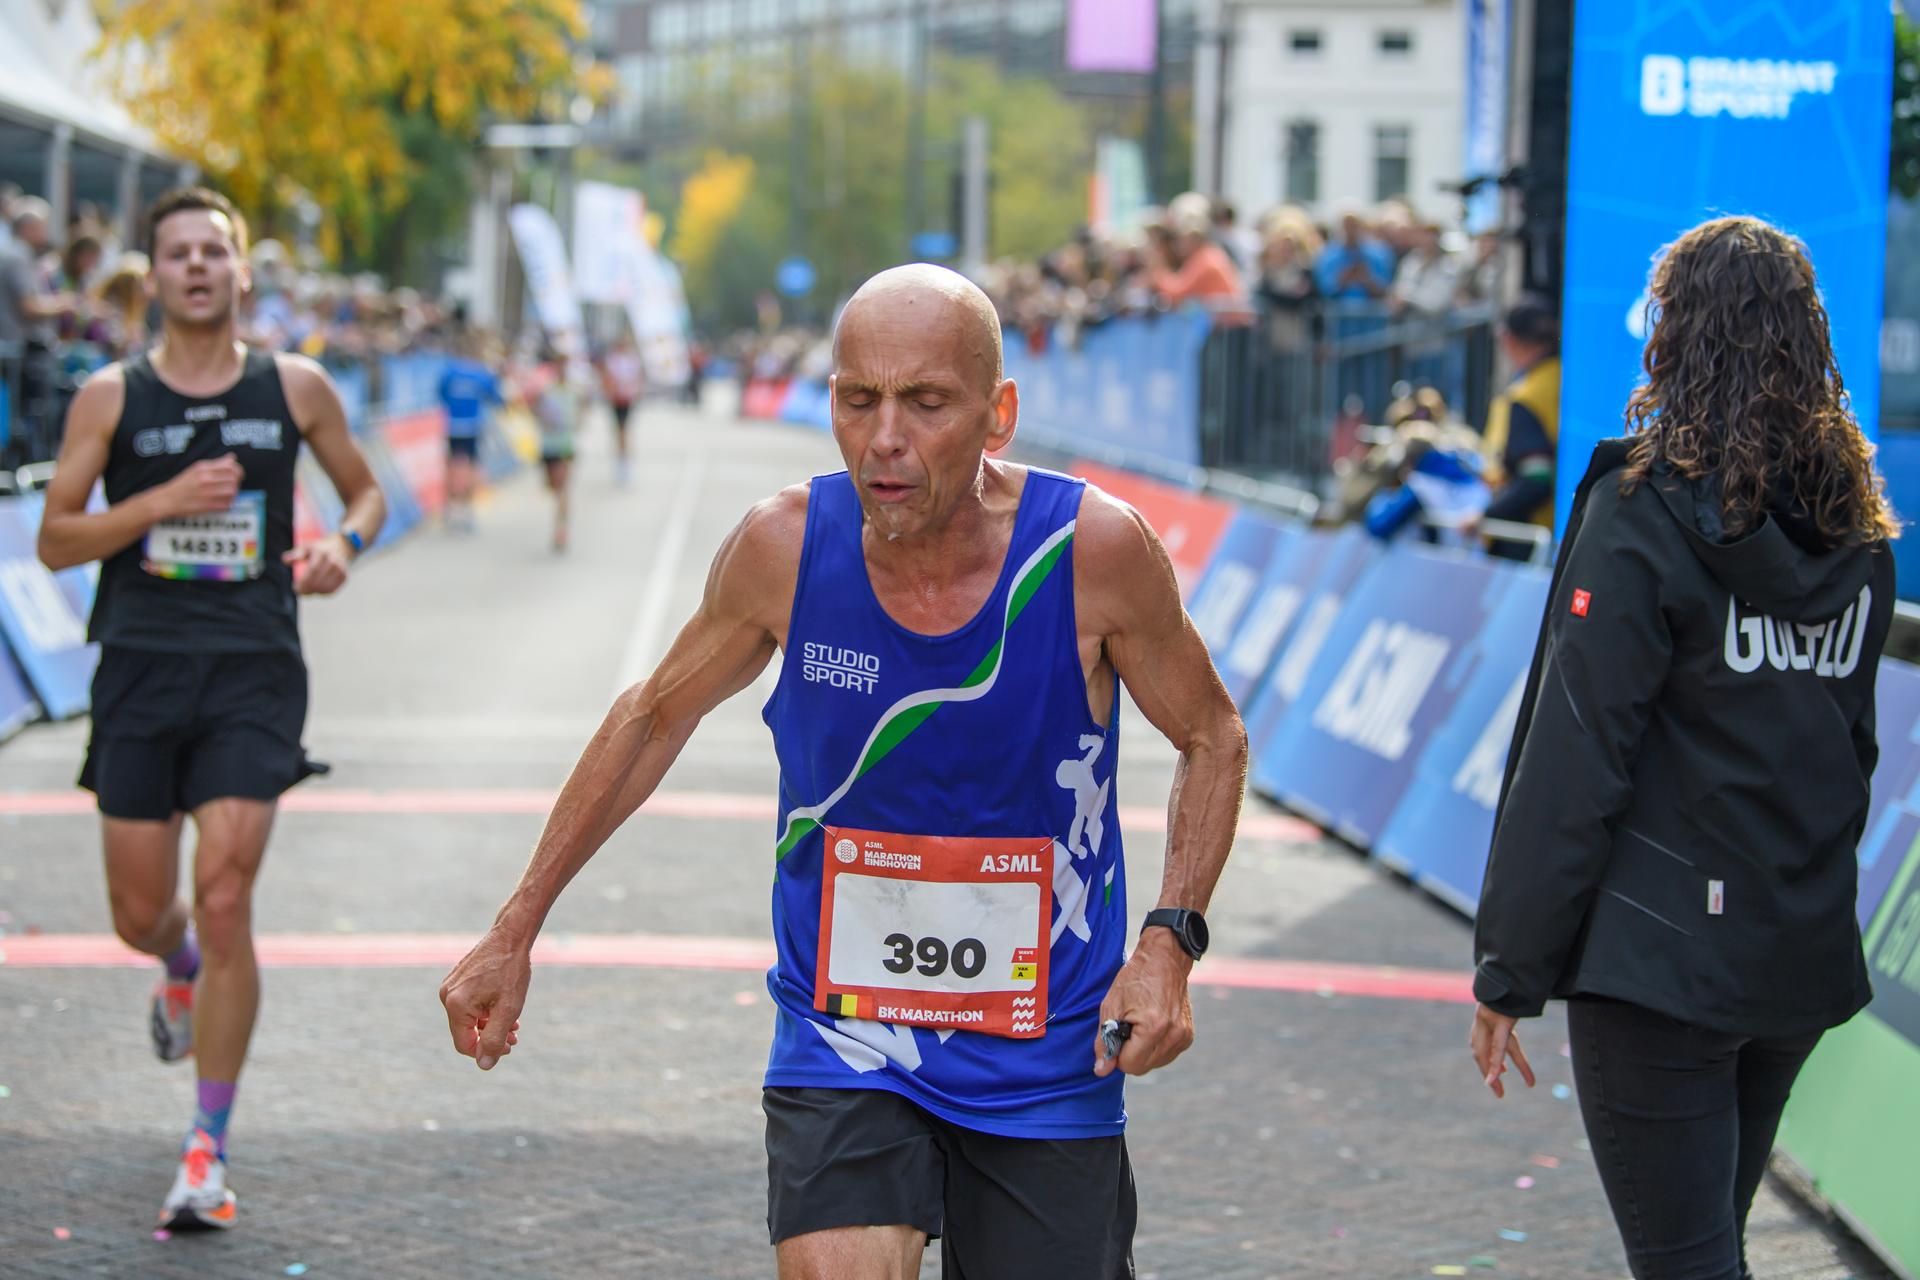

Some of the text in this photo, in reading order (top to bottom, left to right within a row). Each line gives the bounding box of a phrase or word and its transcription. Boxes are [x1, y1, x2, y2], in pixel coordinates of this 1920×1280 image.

[803, 641, 880, 673] STUDIO
[803, 664, 879, 695] SPORT
[864, 841, 884, 849] ASML
[864, 850, 921, 863] MARATHON
[864, 858, 921, 870] EINDHOVEN
[980, 854, 1042, 873] ASML
[882, 933, 987, 979] 390
[877, 1006, 984, 1022] BK MARATHON
